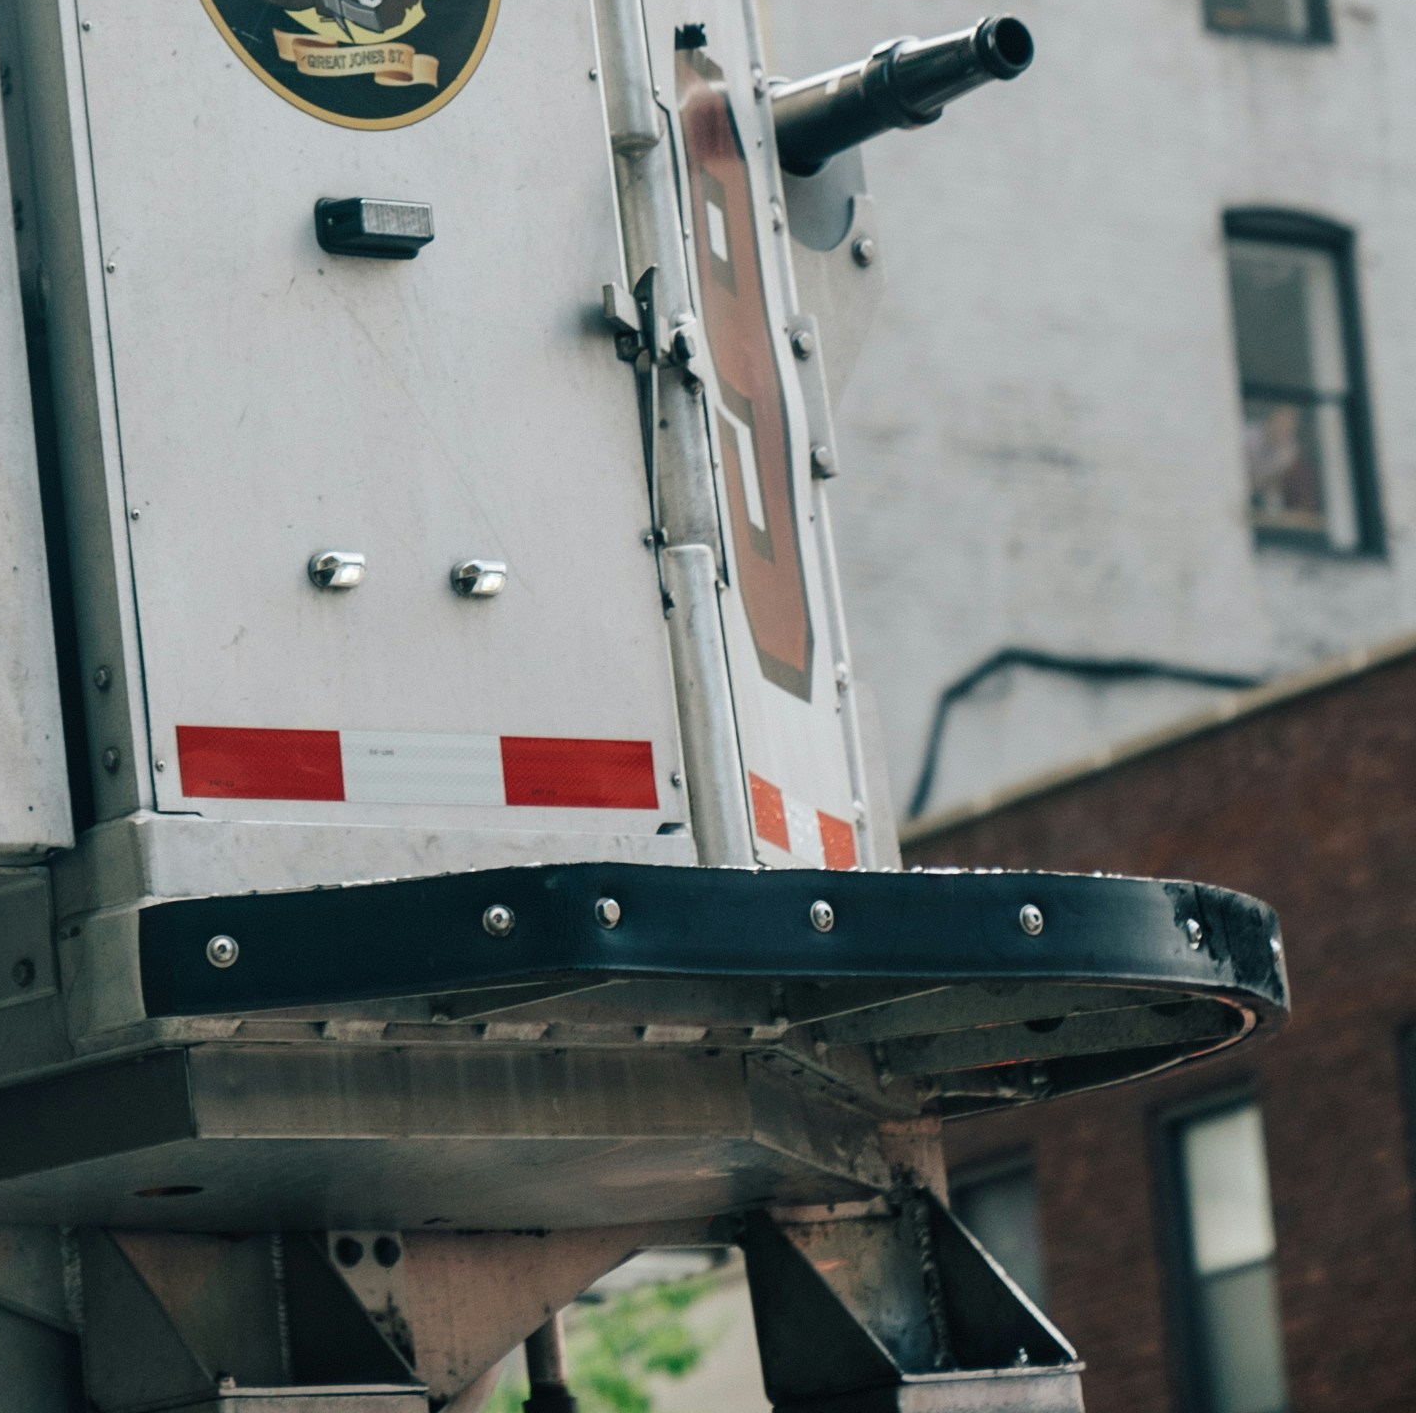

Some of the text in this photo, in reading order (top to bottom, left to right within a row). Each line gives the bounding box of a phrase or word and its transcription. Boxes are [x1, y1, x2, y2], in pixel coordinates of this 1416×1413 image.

[307, 48, 405, 70] GREAT JONES ST.
